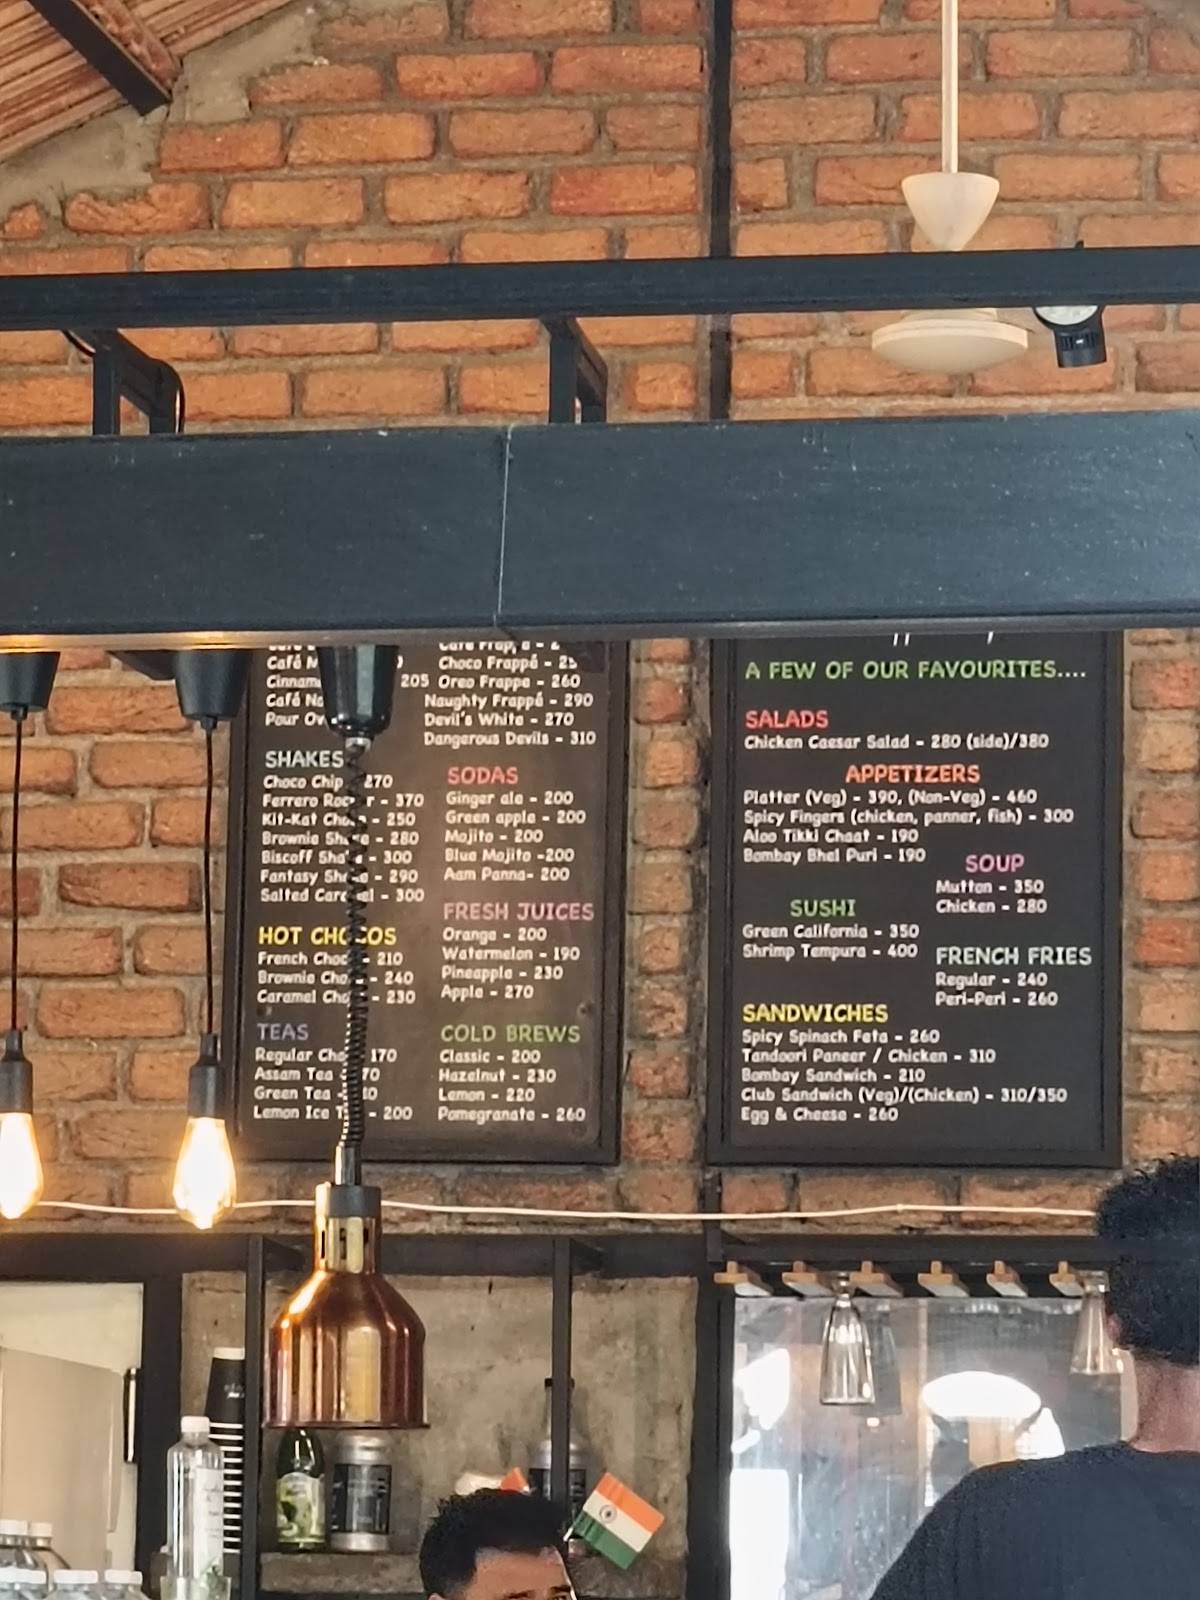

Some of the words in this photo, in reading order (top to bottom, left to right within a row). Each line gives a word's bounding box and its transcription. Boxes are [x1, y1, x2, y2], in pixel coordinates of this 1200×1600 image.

[439, 656, 482, 670] Choco
[745, 662, 760, 679] A
[770, 662, 816, 679] FEW
[826, 661, 853, 679] OF
[863, 660, 908, 679] OUR
[401, 674, 429, 688] 205
[438, 675, 474, 689] Oreo
[552, 674, 580, 688] 260
[425, 694, 487, 711] Naughty
[564, 693, 593, 707] 290
[265, 712, 299, 726] Pour
[425, 711, 472, 726] Devil's
[478, 712, 523, 726] White
[545, 712, 574, 726] 270
[746, 710, 828, 729] SALADS
[424, 732, 499, 749] Dangerous
[506, 731, 549, 745] Devils
[571, 731, 596, 745] 310
[744, 735, 803, 749] Chicken
[867, 734, 909, 749] Salad
[931, 734, 961, 748] 280
[266, 750, 344, 768] SHAKES
[448, 766, 518, 784] SODAS
[846, 764, 980, 783] APPETIZERS
[263, 775, 306, 788] Choco
[312, 774, 343, 792] Chip
[263, 794, 318, 807] Ferrero
[396, 793, 424, 807] 370
[446, 791, 495, 809] Ginger
[501, 791, 523, 805] ale
[545, 791, 573, 805] 200
[744, 790, 800, 804] Platter
[806, 789, 846, 808] (Veg)
[869, 790, 902, 805] 390,
[908, 789, 985, 808] (Non-Veg)
[1007, 789, 1037, 803] 460
[262, 812, 317, 826] Kit-Kat
[387, 812, 415, 826] 250
[445, 810, 489, 824] Green
[496, 810, 535, 827] apple
[557, 810, 586, 824] 200
[744, 809, 784, 827] Spicy
[791, 809, 845, 827] Fingers
[851, 808, 918, 825] (chicken,
[988, 808, 1022, 825] fish)
[1044, 809, 1073, 823] 300
[262, 831, 319, 845] Brownie
[390, 831, 419, 845] 280
[445, 829, 493, 845] Mojito
[515, 829, 543, 843] 200
[743, 829, 777, 843] Aloo
[783, 829, 818, 842] Tikki
[892, 829, 918, 843] 190
[262, 849, 313, 864] Biscoff
[384, 850, 412, 864] 300
[445, 848, 477, 862] Blue
[482, 848, 531, 864] Mojito
[744, 848, 801, 865] Bombay
[846, 848, 877, 862] Puri
[899, 848, 926, 862] 190
[966, 854, 1024, 872] SOUP
[261, 869, 318, 886] Fantasy
[389, 869, 418, 883] 290
[541, 867, 570, 881] 200
[261, 888, 309, 902] Salted
[396, 888, 424, 902] 300
[936, 880, 992, 894] Mutton
[1015, 879, 1044, 893] 350
[444, 902, 508, 920] FRESH
[517, 903, 594, 921] JUICES
[791, 899, 855, 917] SUSHI
[936, 899, 995, 913] Chicken
[1017, 899, 1047, 913] 280
[259, 926, 302, 945] HOT
[443, 927, 496, 945] Orange
[518, 927, 547, 941] 200
[743, 924, 788, 938] Green
[794, 923, 867, 938] California
[890, 924, 919, 938] 350
[258, 951, 308, 965] French
[377, 951, 403, 965] 210
[442, 946, 533, 960] Watermelon
[554, 947, 580, 960] 190
[743, 944, 795, 961] Shrimp
[801, 944, 866, 961] Tempura
[888, 944, 918, 957] 400
[937, 946, 1019, 965] FRENCH
[1029, 946, 1091, 965] FRIES
[258, 970, 315, 984] Brownie
[385, 971, 413, 985] 240
[442, 965, 512, 983] Pineapple
[534, 966, 563, 980] 230
[936, 972, 996, 990] Regular
[1018, 972, 1047, 986] 240
[257, 989, 316, 1003] Caramel
[386, 990, 415, 1004] 230
[441, 984, 483, 1002] Apple
[505, 985, 534, 999] 270
[936, 991, 1005, 1006] Peri-Peri
[1028, 992, 1058, 1006] 260
[743, 1004, 888, 1022] SANDWICHES
[257, 1023, 308, 1040] TEAS
[441, 1024, 496, 1042] COLD
[506, 1024, 580, 1043] BREWS
[742, 1029, 783, 1047] Spicy
[790, 1029, 847, 1046] Spinach
[853, 1029, 888, 1043] Feta
[910, 1029, 940, 1043] 260
[255, 1047, 313, 1065] Regular
[440, 1049, 490, 1063] Classic
[512, 1049, 541, 1063] 200
[742, 1048, 807, 1062] Tandoori
[813, 1048, 866, 1062] Paneer
[888, 1048, 947, 1063] Chicken
[970, 1049, 996, 1063] 310
[255, 1067, 300, 1080] Assam
[307, 1067, 333, 1081] Tea
[439, 1068, 505, 1082] Hazelnut
[527, 1069, 556, 1083] 230
[742, 1068, 799, 1085] Bombay
[806, 1068, 877, 1082] Sandwich
[899, 1068, 925, 1082] 210
[254, 1086, 298, 1099] Green
[304, 1086, 330, 1100] Tea
[439, 1088, 485, 1101] Lemon
[506, 1088, 535, 1102] 220
[741, 1087, 775, 1101] Club
[782, 1087, 853, 1101] Sandwich
[1002, 1087, 1067, 1103] 310/350
[254, 1105, 299, 1119] Lemon
[306, 1105, 329, 1119] Ice
[384, 1106, 412, 1120] 200
[438, 1106, 535, 1125] Pomegranate
[556, 1108, 586, 1121] 260
[741, 1107, 769, 1125] Egg
[775, 1107, 787, 1121] &
[793, 1107, 846, 1121] Cheese
[869, 1107, 898, 1121] 260
